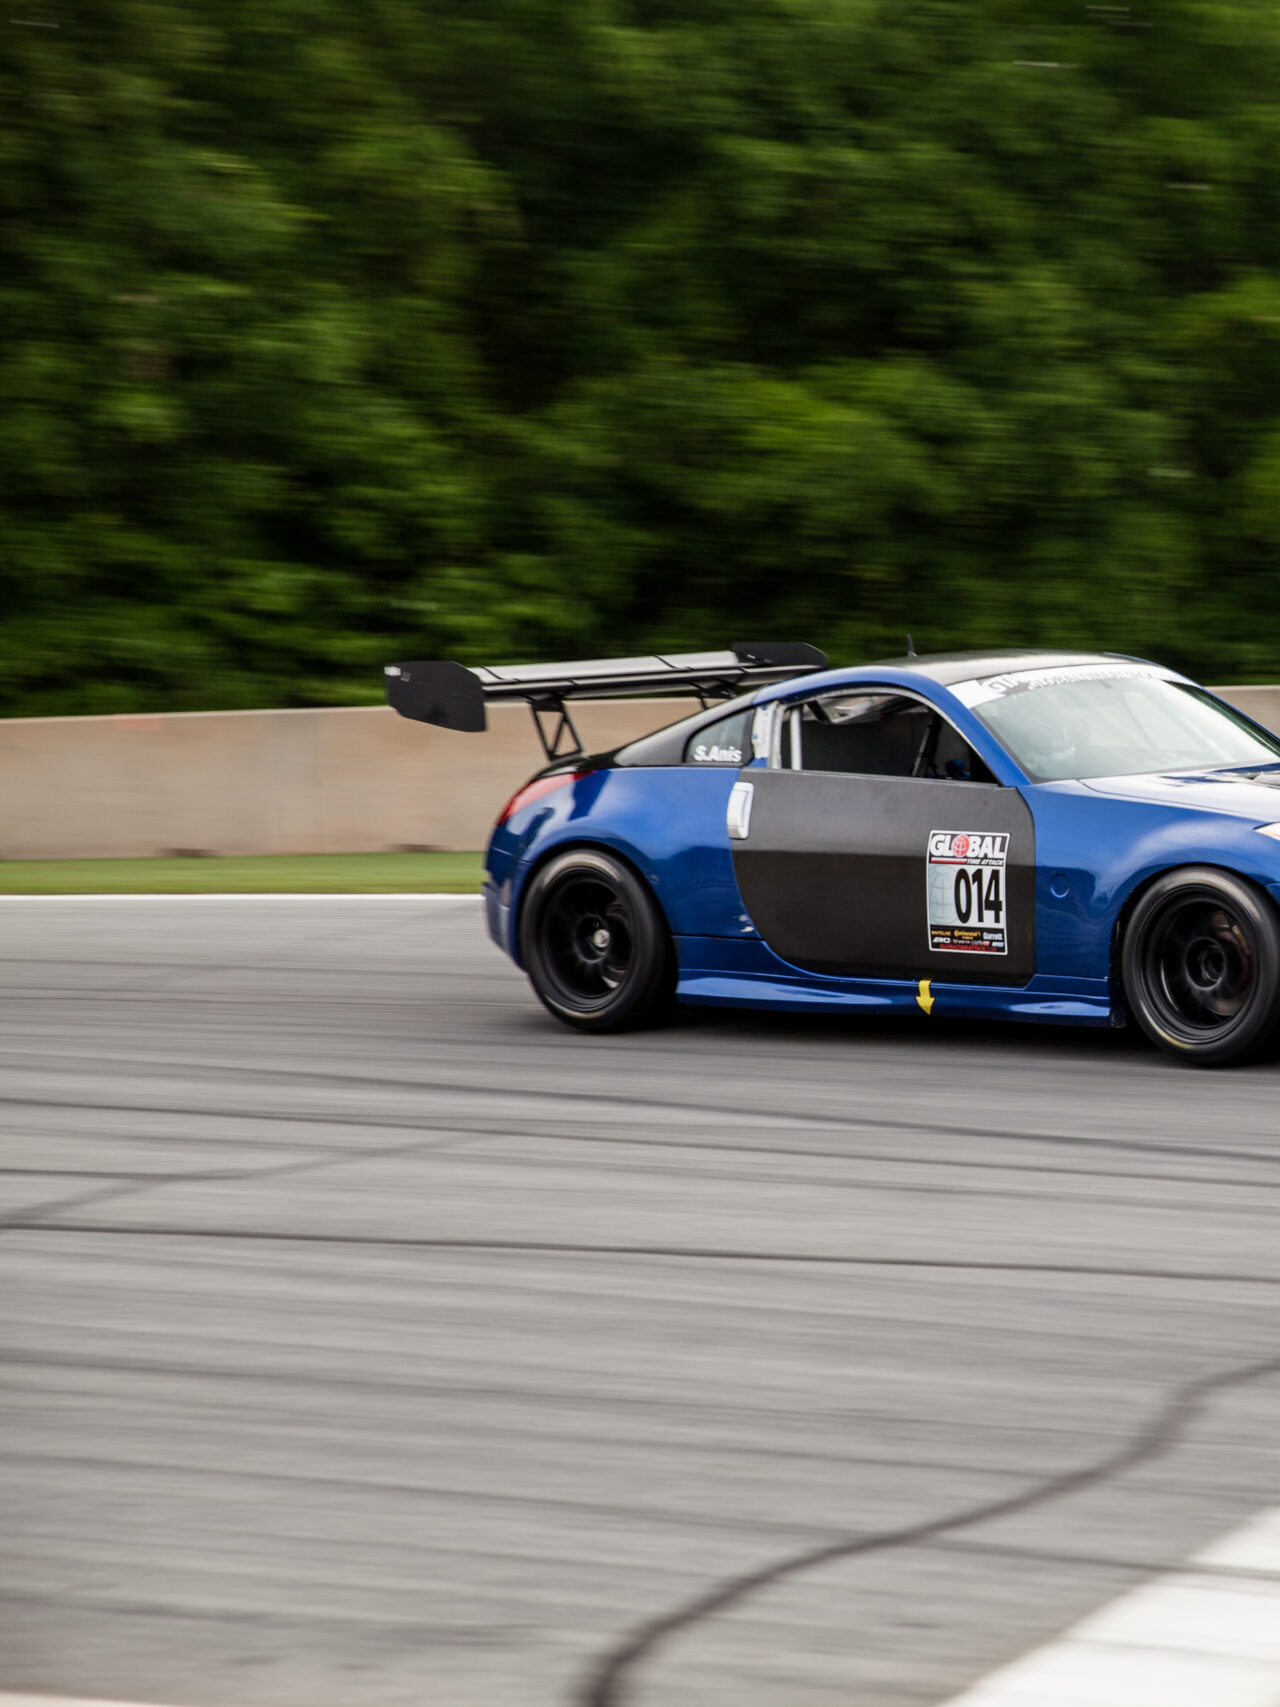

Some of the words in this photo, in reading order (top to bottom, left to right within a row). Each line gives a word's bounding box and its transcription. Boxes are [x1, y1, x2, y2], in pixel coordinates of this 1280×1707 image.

[694, 745, 742, 762] S.Anis
[930, 834, 1005, 858] GLOBAL
[954, 868, 1002, 924] 014
